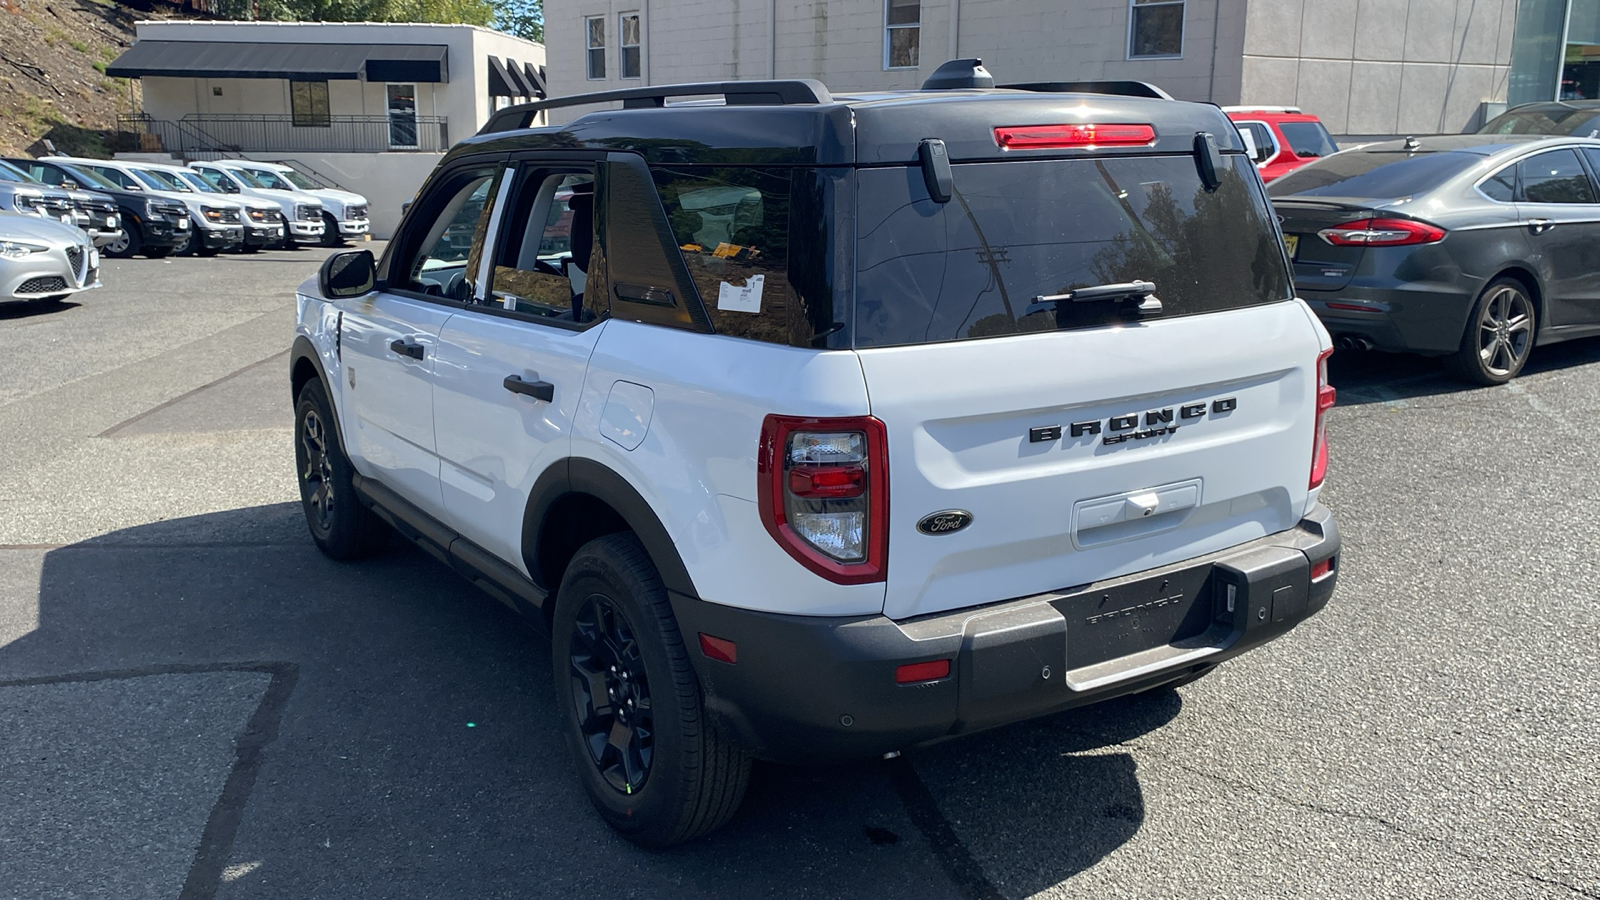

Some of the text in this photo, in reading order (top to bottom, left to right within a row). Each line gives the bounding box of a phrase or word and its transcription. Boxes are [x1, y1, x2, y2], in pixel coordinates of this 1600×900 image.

[1029, 397, 1237, 443] BRONCO
[1102, 424, 1181, 446] SPORT
[930, 514, 963, 532] Ford
[1085, 593, 1184, 626] BRONCO
